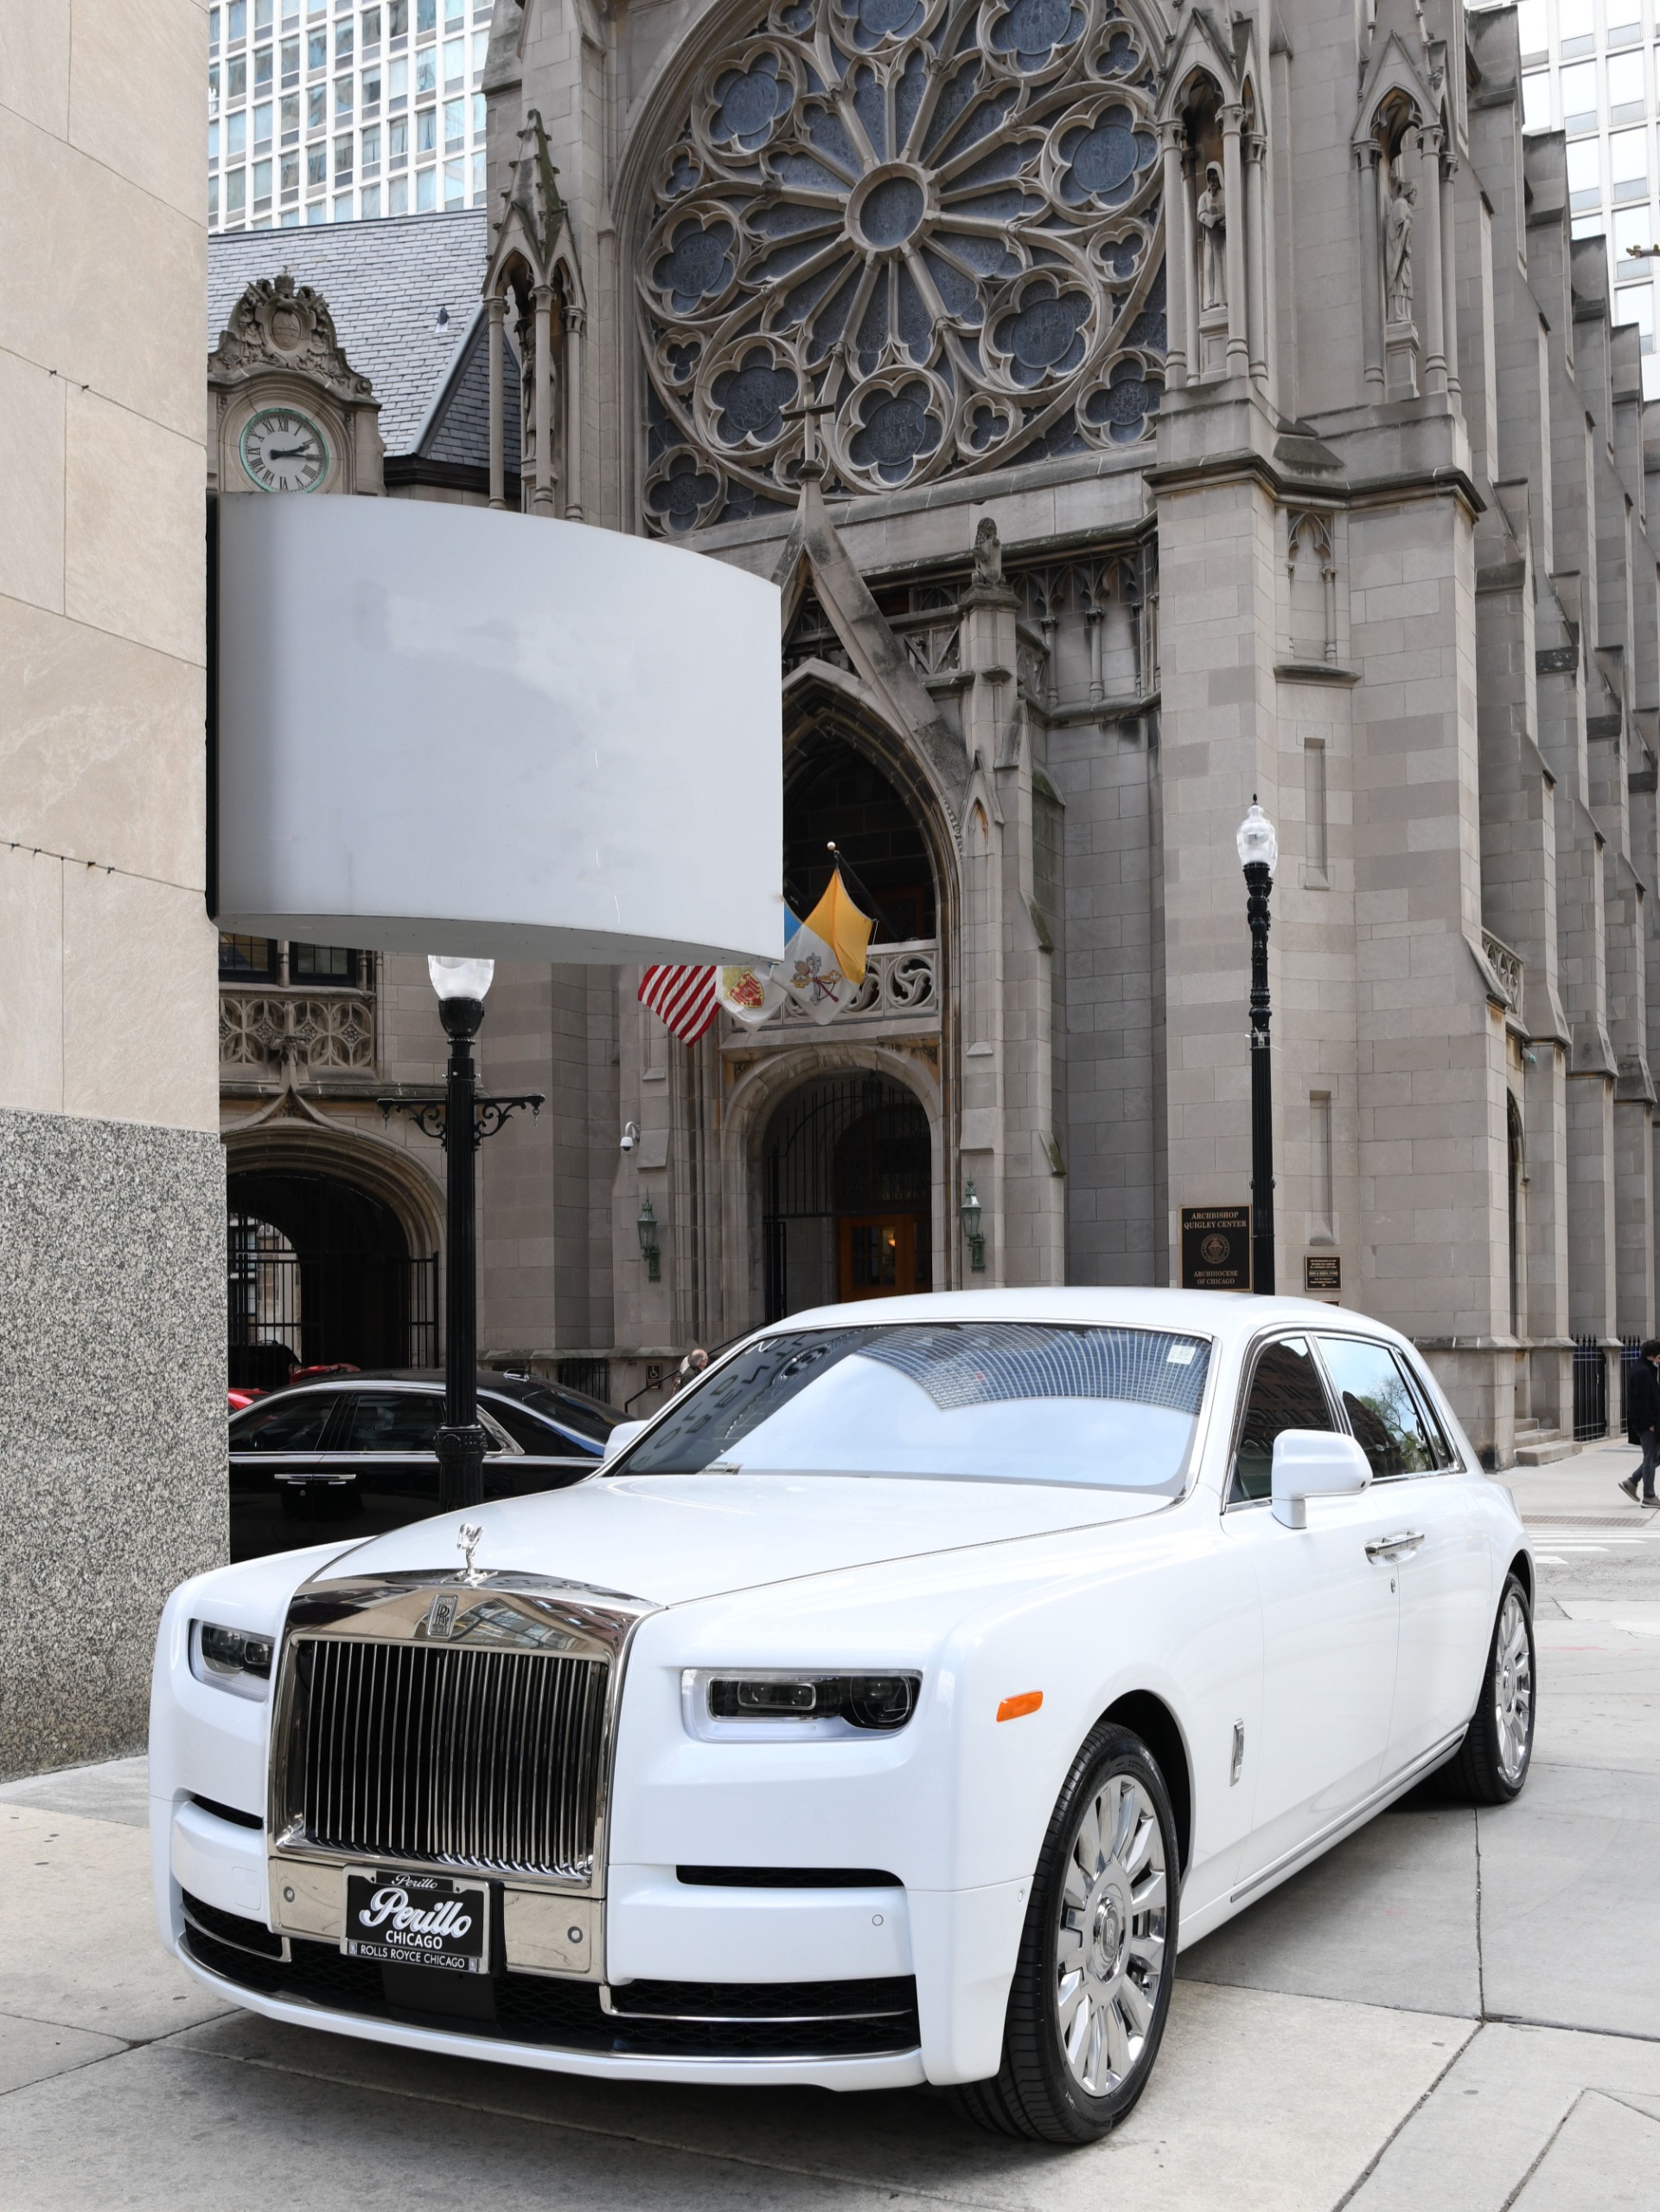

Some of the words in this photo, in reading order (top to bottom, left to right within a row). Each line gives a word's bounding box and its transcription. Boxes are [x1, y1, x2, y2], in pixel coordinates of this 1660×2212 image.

[277, 418, 289, 433] XII
[1191, 1211, 1239, 1220] ARCHBISHOP
[1184, 1221, 1216, 1230] QUIGLEY
[1216, 1220, 1247, 1228] CENTER
[391, 1874, 438, 1889] Perillo
[359, 1887, 472, 1938] Perillo
[386, 1930, 443, 1949] CHICAGO
[361, 1945, 388, 1958] ROLLS
[390, 1948, 421, 1963] ROYCE
[424, 1954, 465, 1968] CHICAGO
